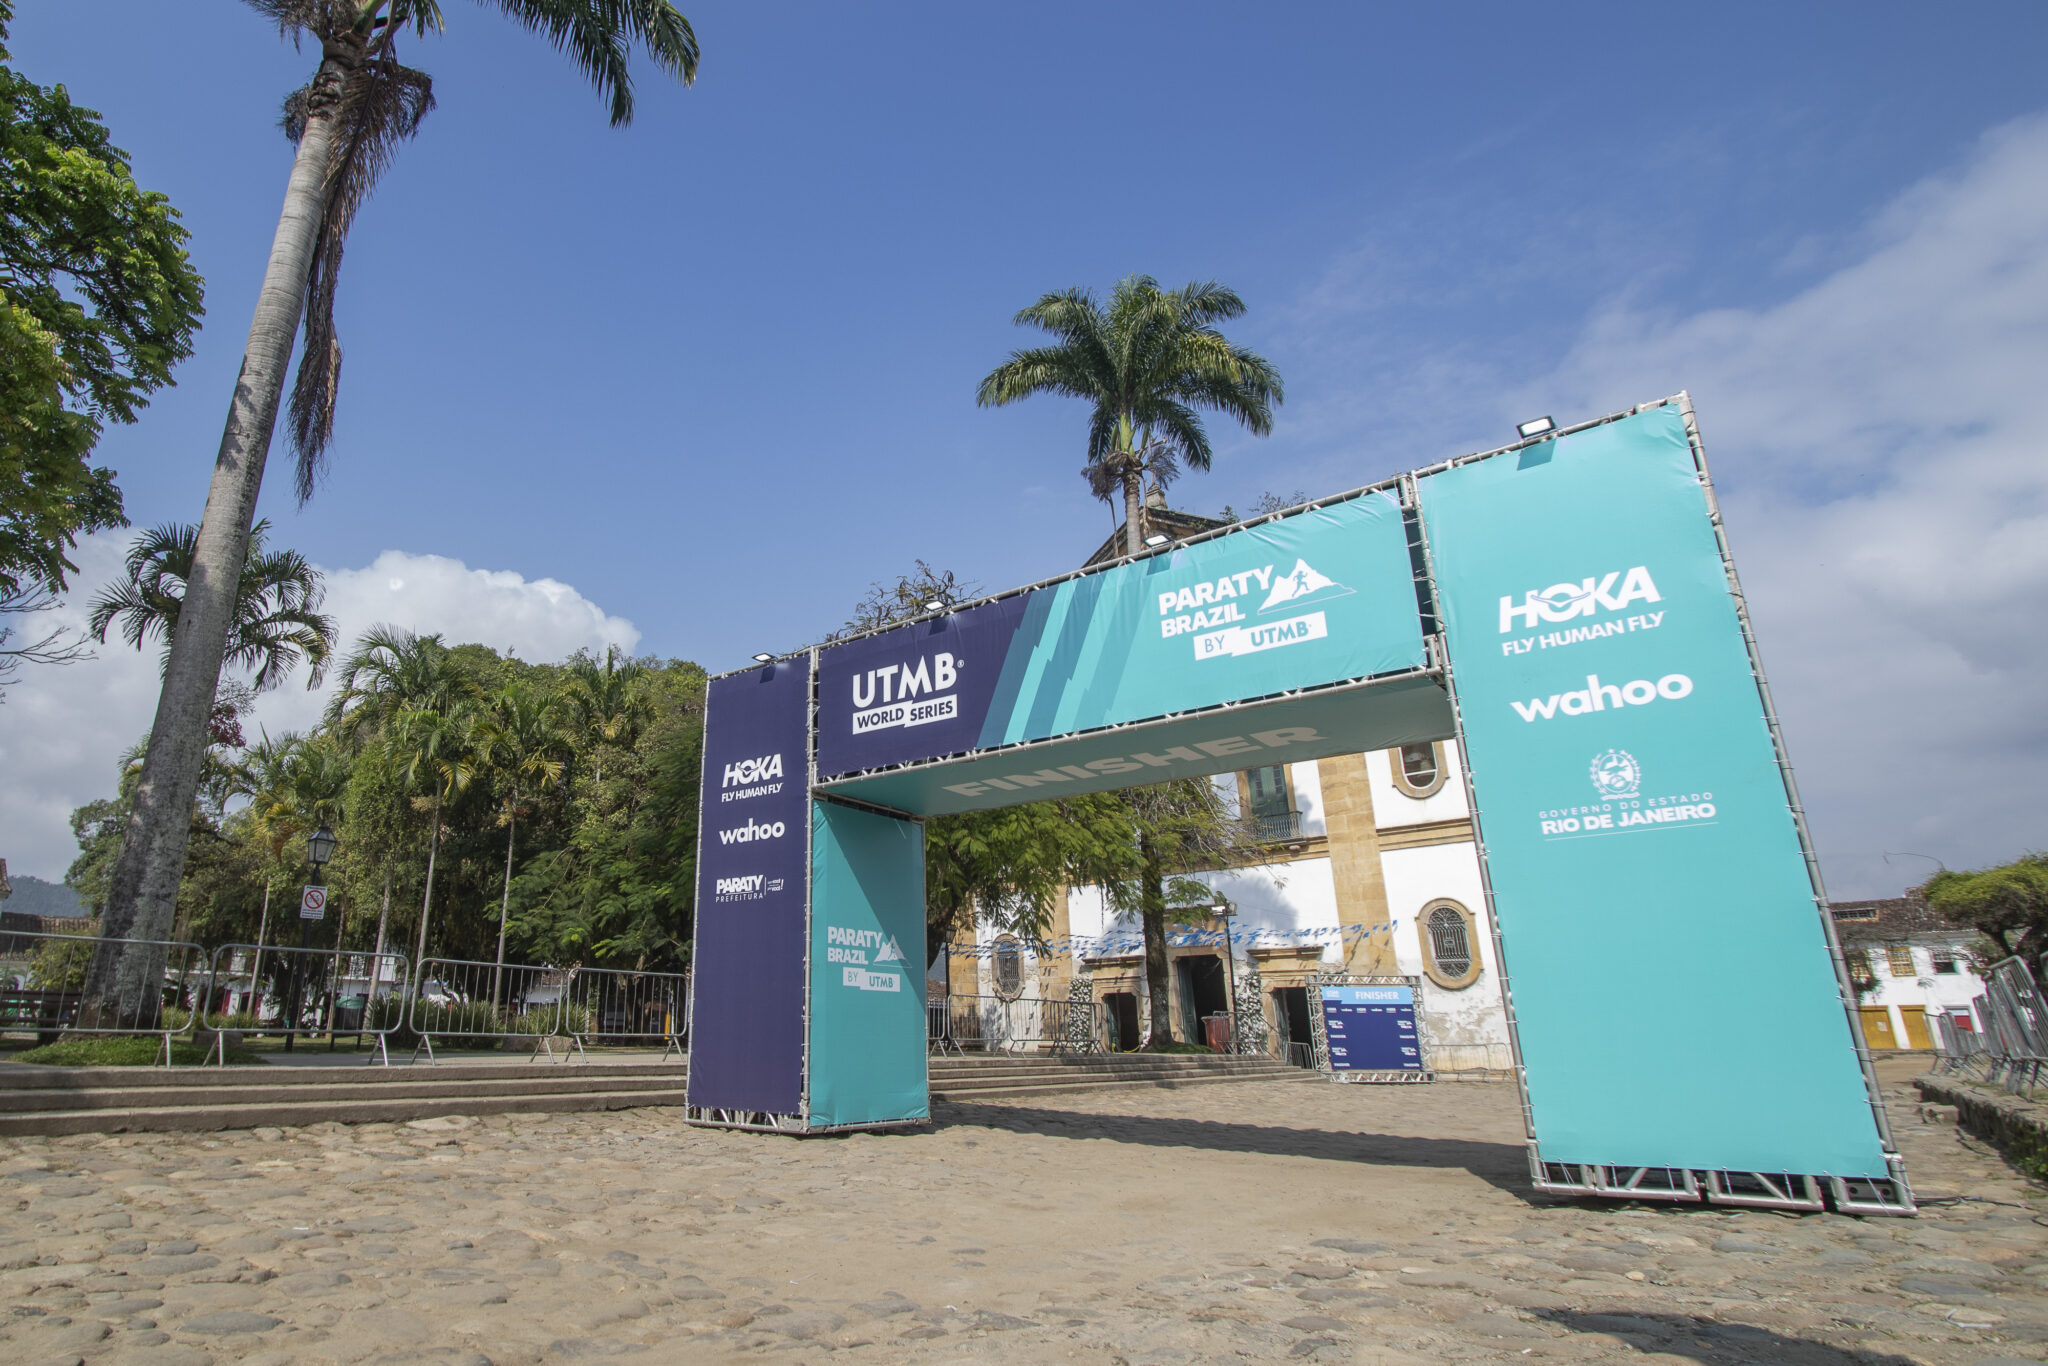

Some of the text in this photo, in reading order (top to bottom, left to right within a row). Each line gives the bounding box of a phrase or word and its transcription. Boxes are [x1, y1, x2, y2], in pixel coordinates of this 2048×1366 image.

[1159, 564, 1274, 616] PARATY
[1499, 565, 1662, 634] HOKA
[1161, 602, 1246, 639] BRAZIL
[1502, 611, 1666, 656] FLY HUMAN FLY
[1204, 621, 1309, 653] BY UTMB
[1509, 674, 1693, 723] wahoo
[857, 700, 953, 729] WORLD SERIES
[722, 753, 784, 788] HOKA
[943, 727, 1329, 798] FINISHER
[721, 783, 783, 802] FLY HUMAN FLY
[1539, 792, 1713, 819] GOVERNO DO ESTADO
[719, 818, 785, 845] wahoo
[1540, 803, 1717, 835] RIO DE JANEIRO
[715, 892, 764, 903] PREFEITURA
[716, 875, 764, 895] PARATY
[827, 926, 883, 949] PARATY
[827, 947, 869, 965] BRAZIL
[847, 972, 894, 988] BY UTMB
[1355, 991, 1400, 1000] FINISHER
